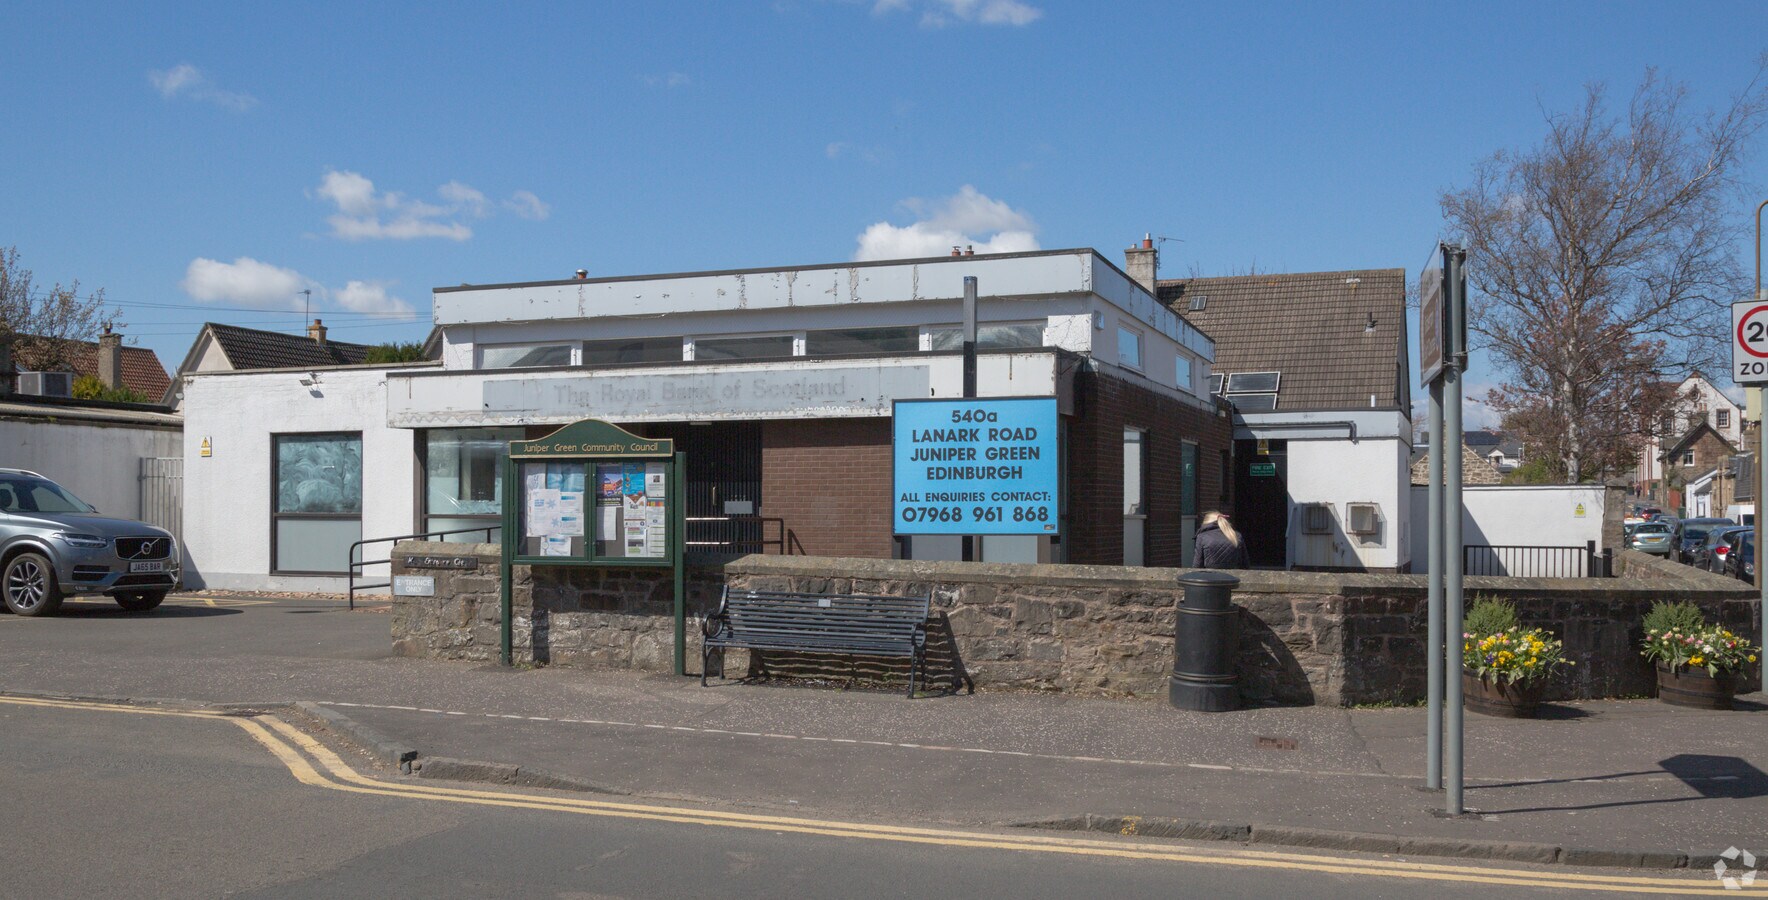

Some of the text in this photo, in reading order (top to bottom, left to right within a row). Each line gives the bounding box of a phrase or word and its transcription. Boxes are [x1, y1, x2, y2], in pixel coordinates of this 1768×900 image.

[1747, 321, 1768, 343] 2
[1740, 362, 1768, 375] ZO
[553, 375, 846, 403] The Royal Bank of Scotland
[951, 409, 998, 423] 540a
[912, 427, 1037, 442] LANARK ROAD
[524, 442, 658, 453] Juniper Green Community Council
[910, 446, 1040, 461] JUNIPER GREEN
[926, 466, 1023, 480] EDINBURGH
[900, 491, 1051, 502] ALL ENQUIRIES CONTACT:
[902, 506, 1049, 522] 07968 961 868
[405, 585, 422, 593] ONLY
